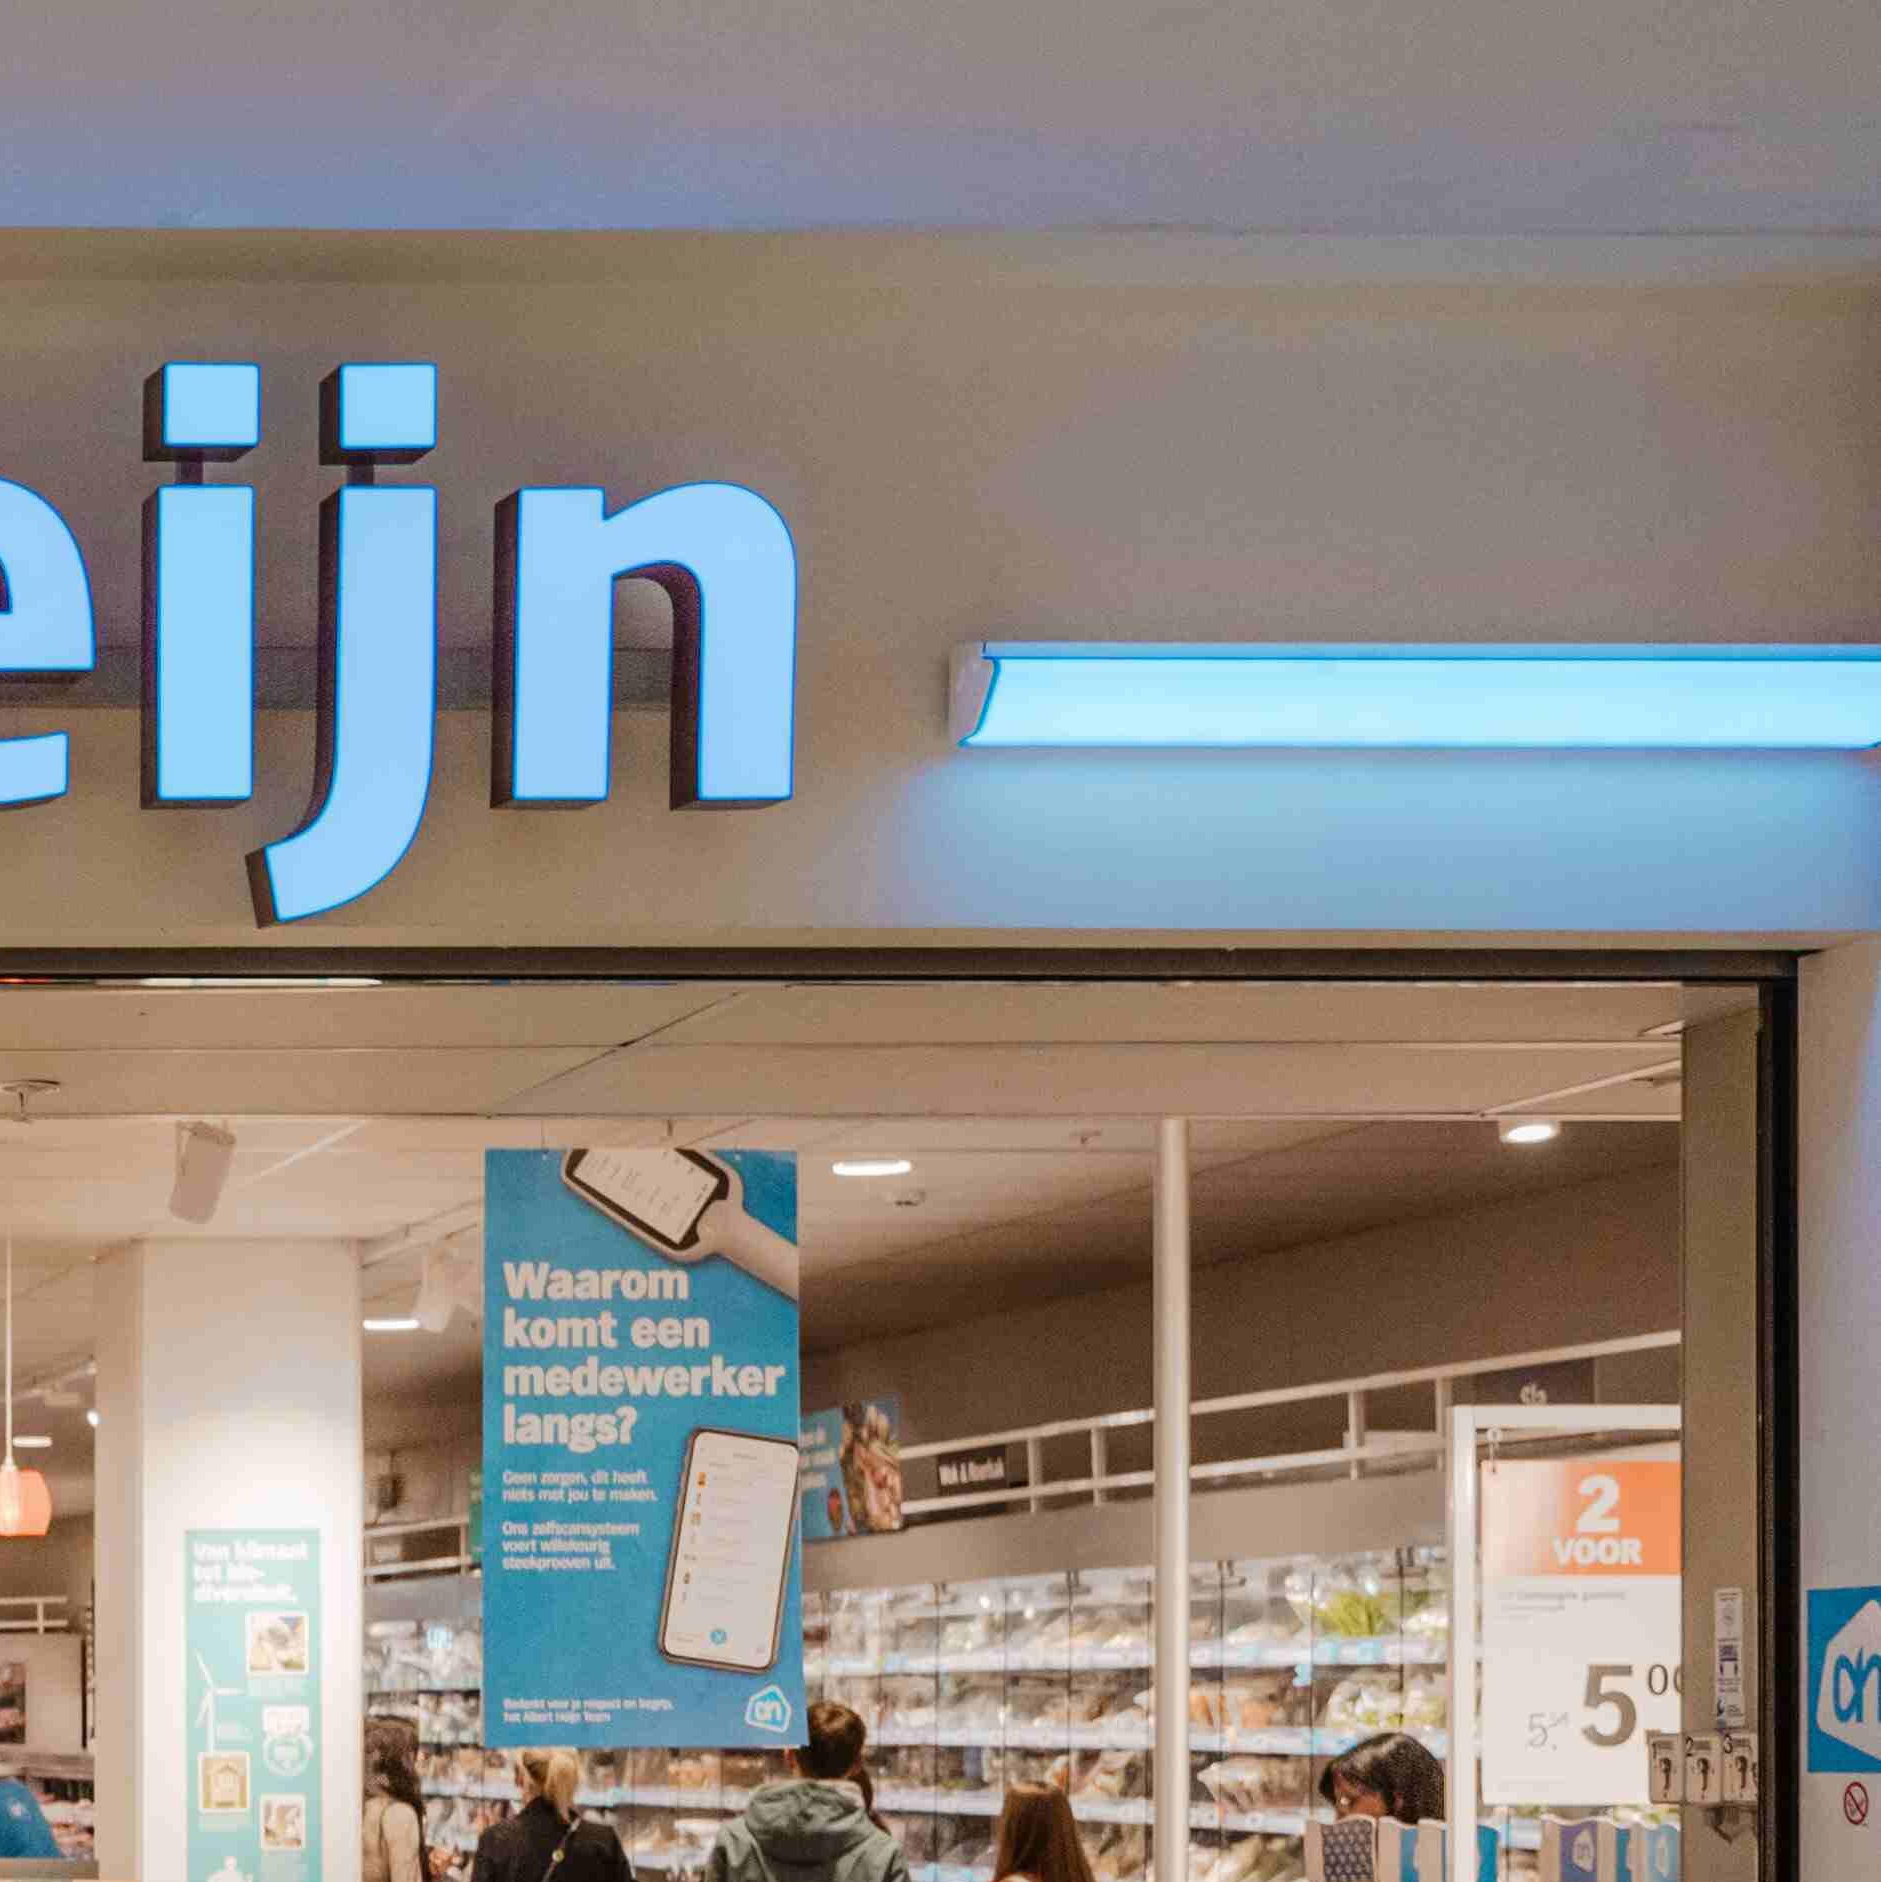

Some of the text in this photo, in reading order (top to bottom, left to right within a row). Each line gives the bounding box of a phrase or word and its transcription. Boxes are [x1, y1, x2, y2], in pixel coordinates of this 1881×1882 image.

[502, 1261, 690, 1301] Waarom
[503, 1306, 711, 1349] komt een
[503, 1355, 786, 1398] medewerker
[503, 1403, 638, 1454] langs?
[1575, 1473, 1622, 1534] 2
[1551, 1535, 1644, 1567] VOOR
